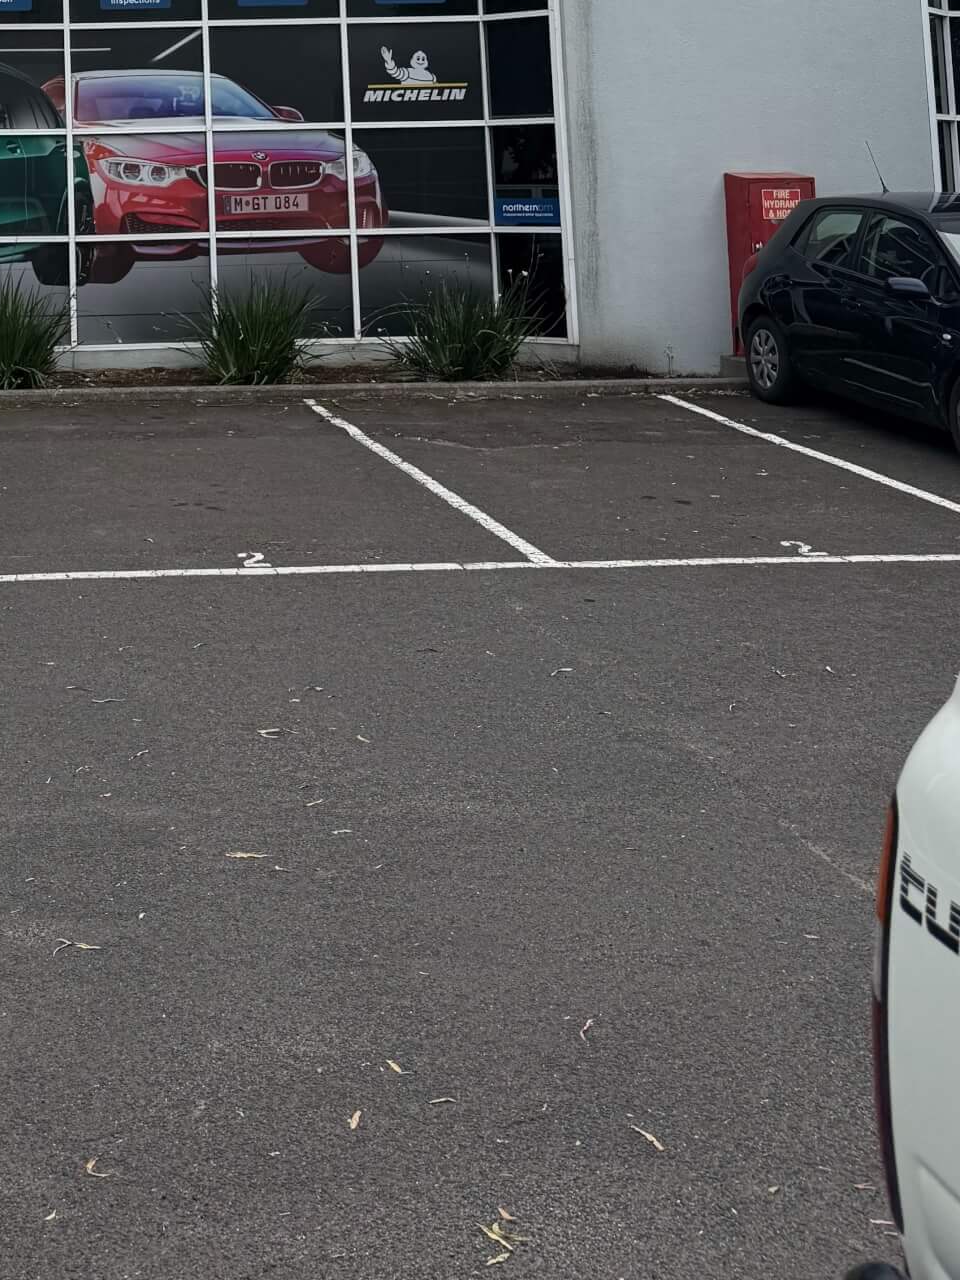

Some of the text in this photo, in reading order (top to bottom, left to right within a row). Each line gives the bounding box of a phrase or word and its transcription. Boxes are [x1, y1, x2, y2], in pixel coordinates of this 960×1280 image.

[363, 87, 468, 103] MICHELIN
[275, 195, 299, 209] 084
[773, 190, 790, 199] FIRE
[237, 552, 272, 568] 2
